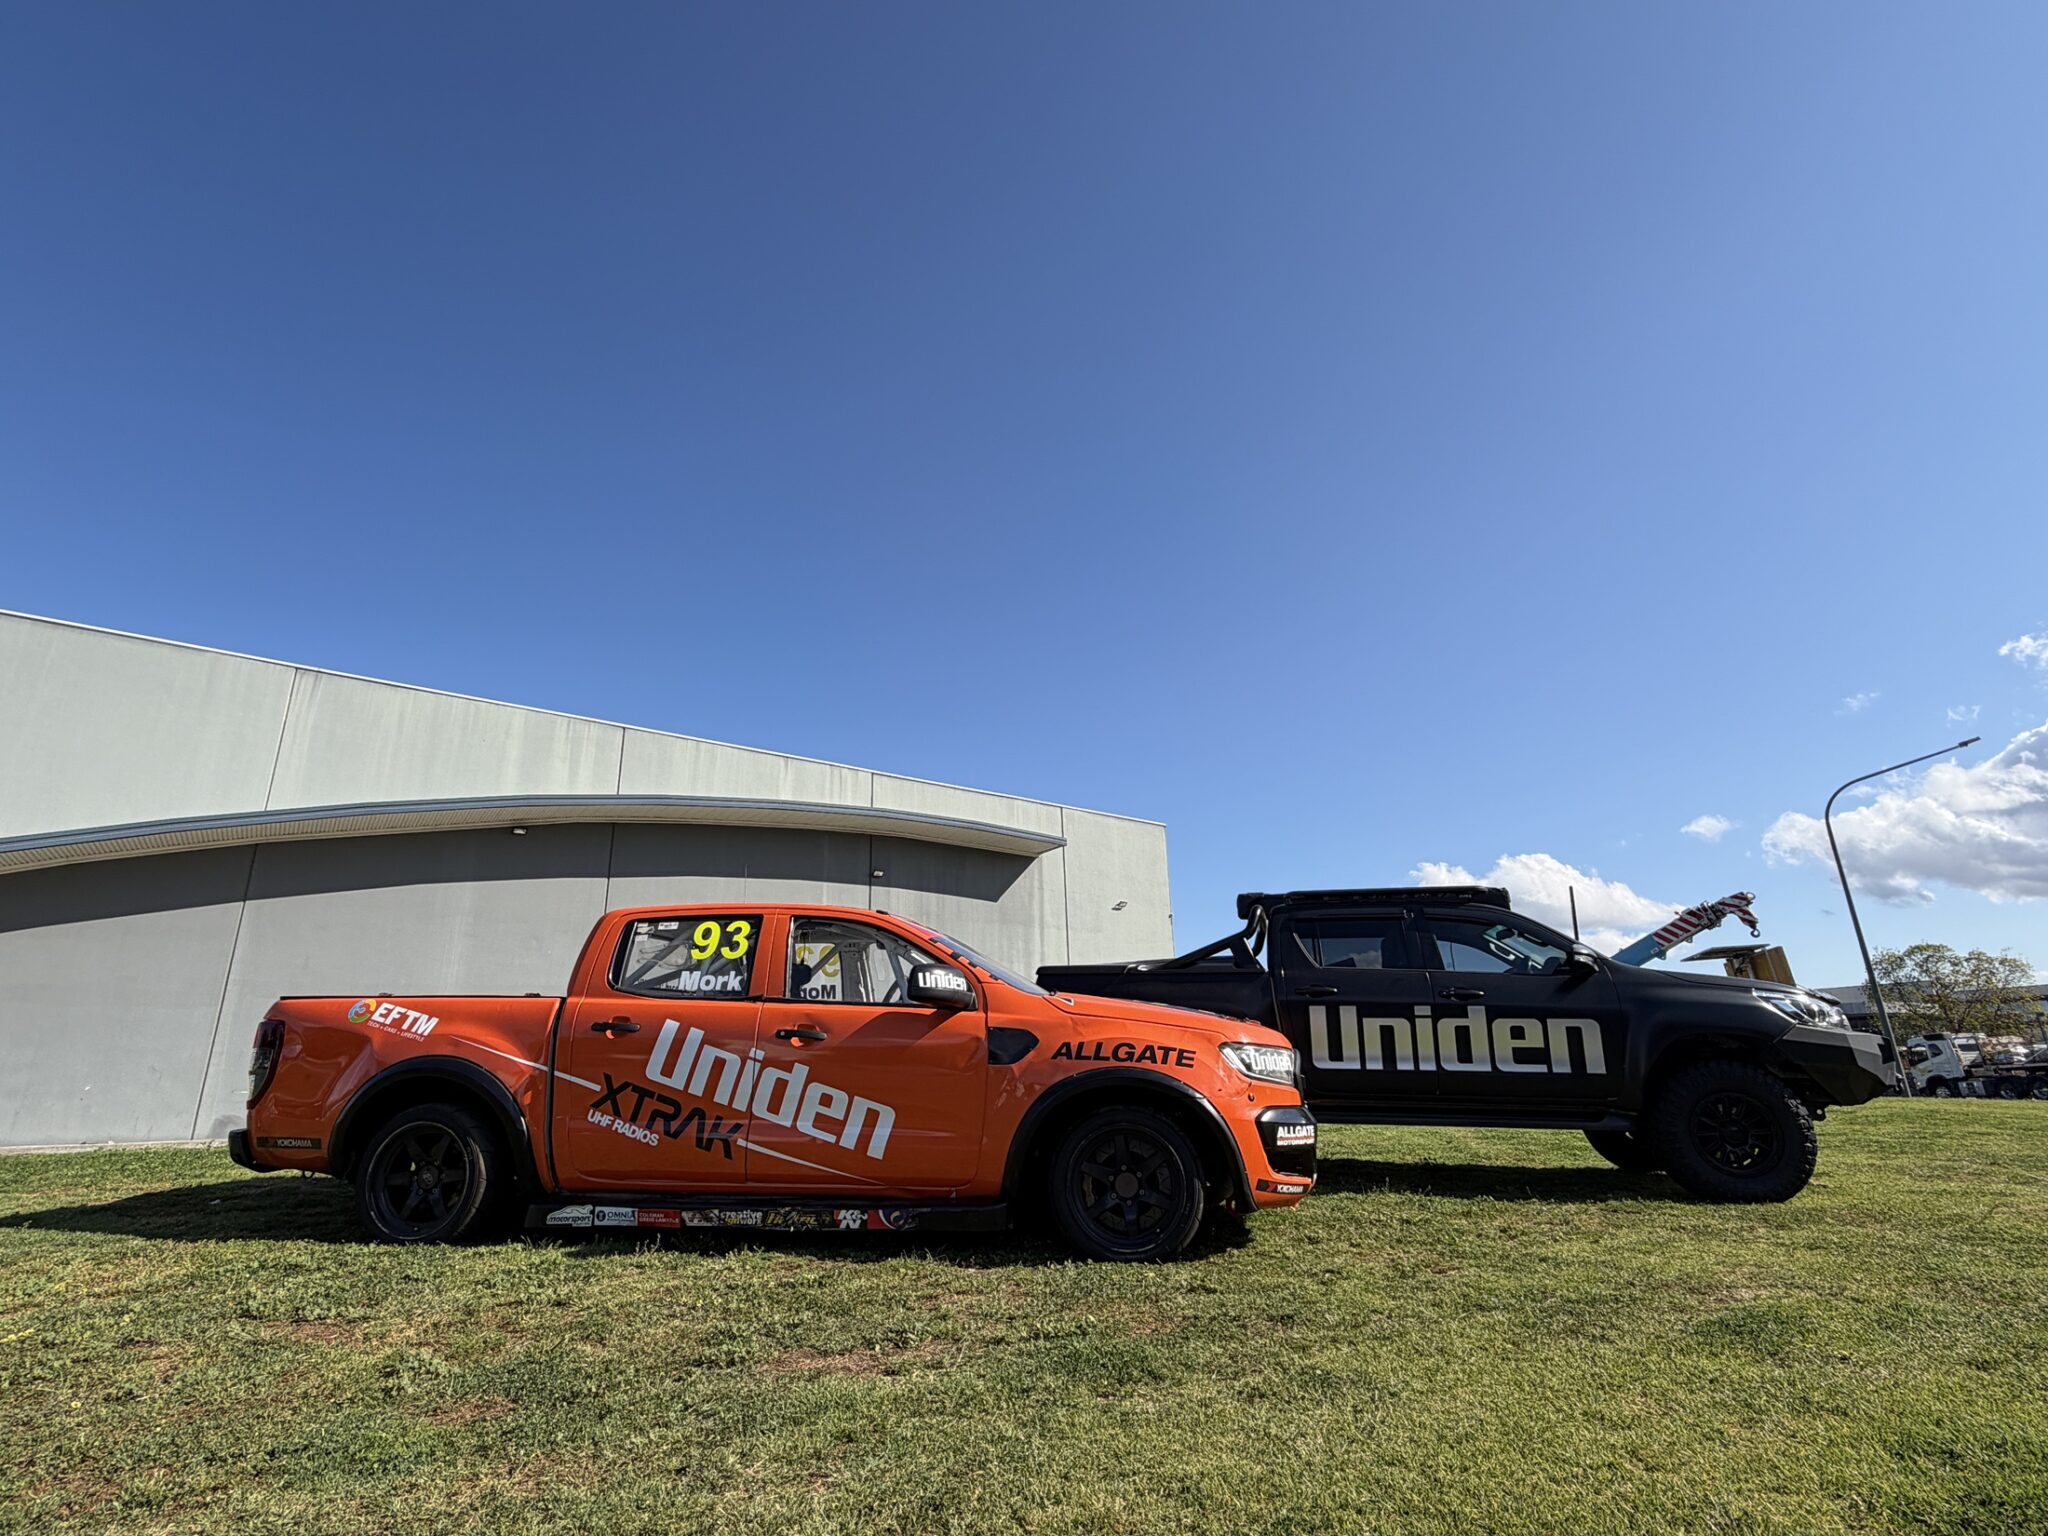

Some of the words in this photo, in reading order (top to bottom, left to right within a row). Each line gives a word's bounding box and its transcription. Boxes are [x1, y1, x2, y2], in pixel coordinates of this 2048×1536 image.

[691, 921, 751, 960] 93
[679, 970, 742, 991] Mork
[918, 971, 967, 991] Uniden
[371, 1002, 439, 1036] EFTM
[1309, 1005, 1607, 1074] Uniden
[1051, 1041, 1196, 1068] ALLGATE
[645, 1018, 896, 1160] Uniden
[587, 1109, 613, 1131] UHF
[612, 1115, 660, 1147] RADIOS
[590, 1072, 744, 1160] XTRAK
[276, 1139, 312, 1147] YOKOHAMA
[1277, 1125, 1315, 1138] ALLGATE
[548, 1215, 591, 1225] motorsport
[720, 1209, 763, 1219] creative
